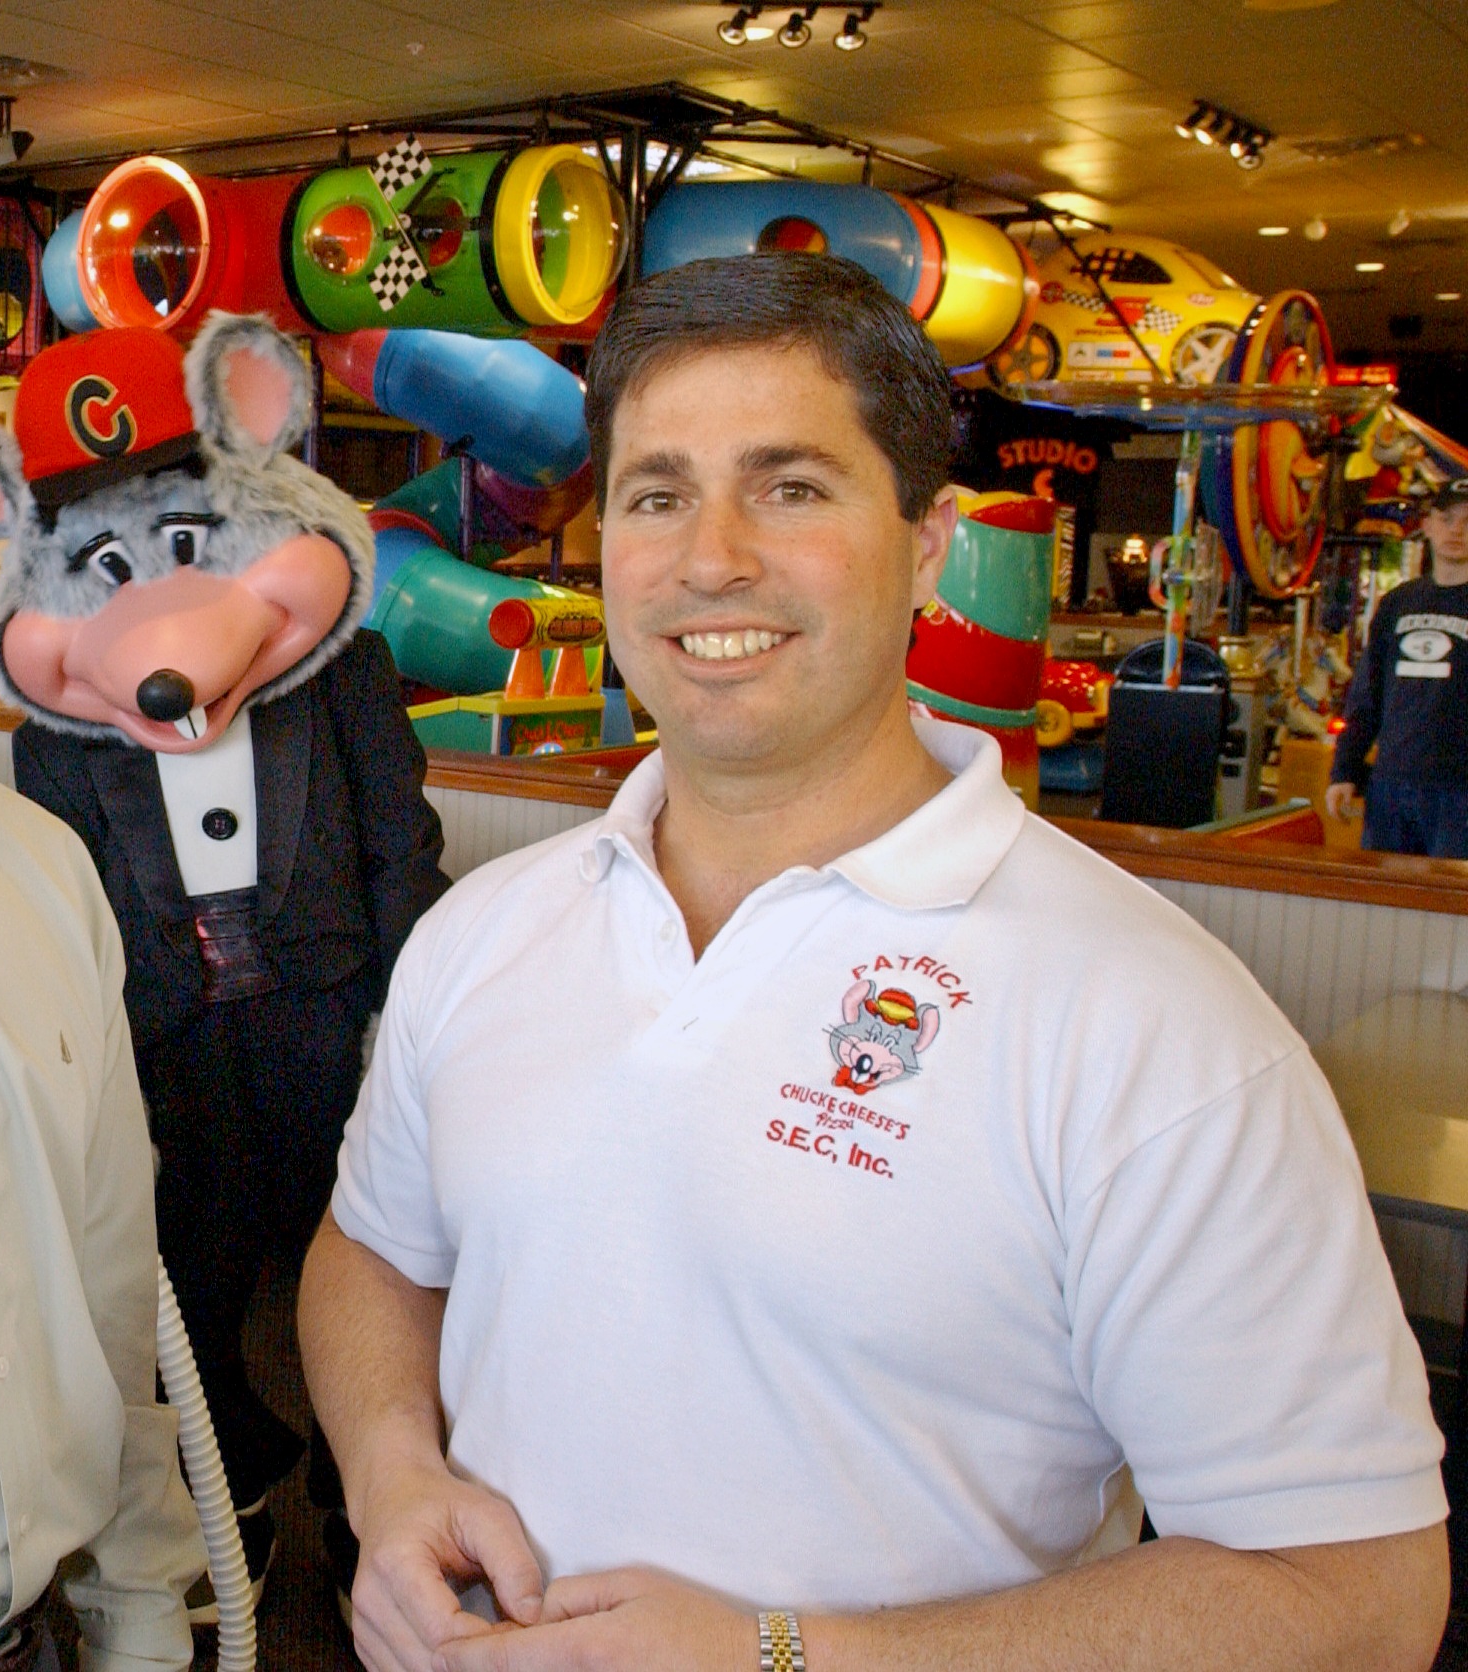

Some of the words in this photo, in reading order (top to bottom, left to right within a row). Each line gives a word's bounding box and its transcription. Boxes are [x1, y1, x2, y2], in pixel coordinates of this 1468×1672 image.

[65, 373, 138, 459] C
[997, 438, 1098, 474] STUDIO
[851, 954, 974, 1009] PATRICK
[848, 1142, 894, 1179] Inc.
